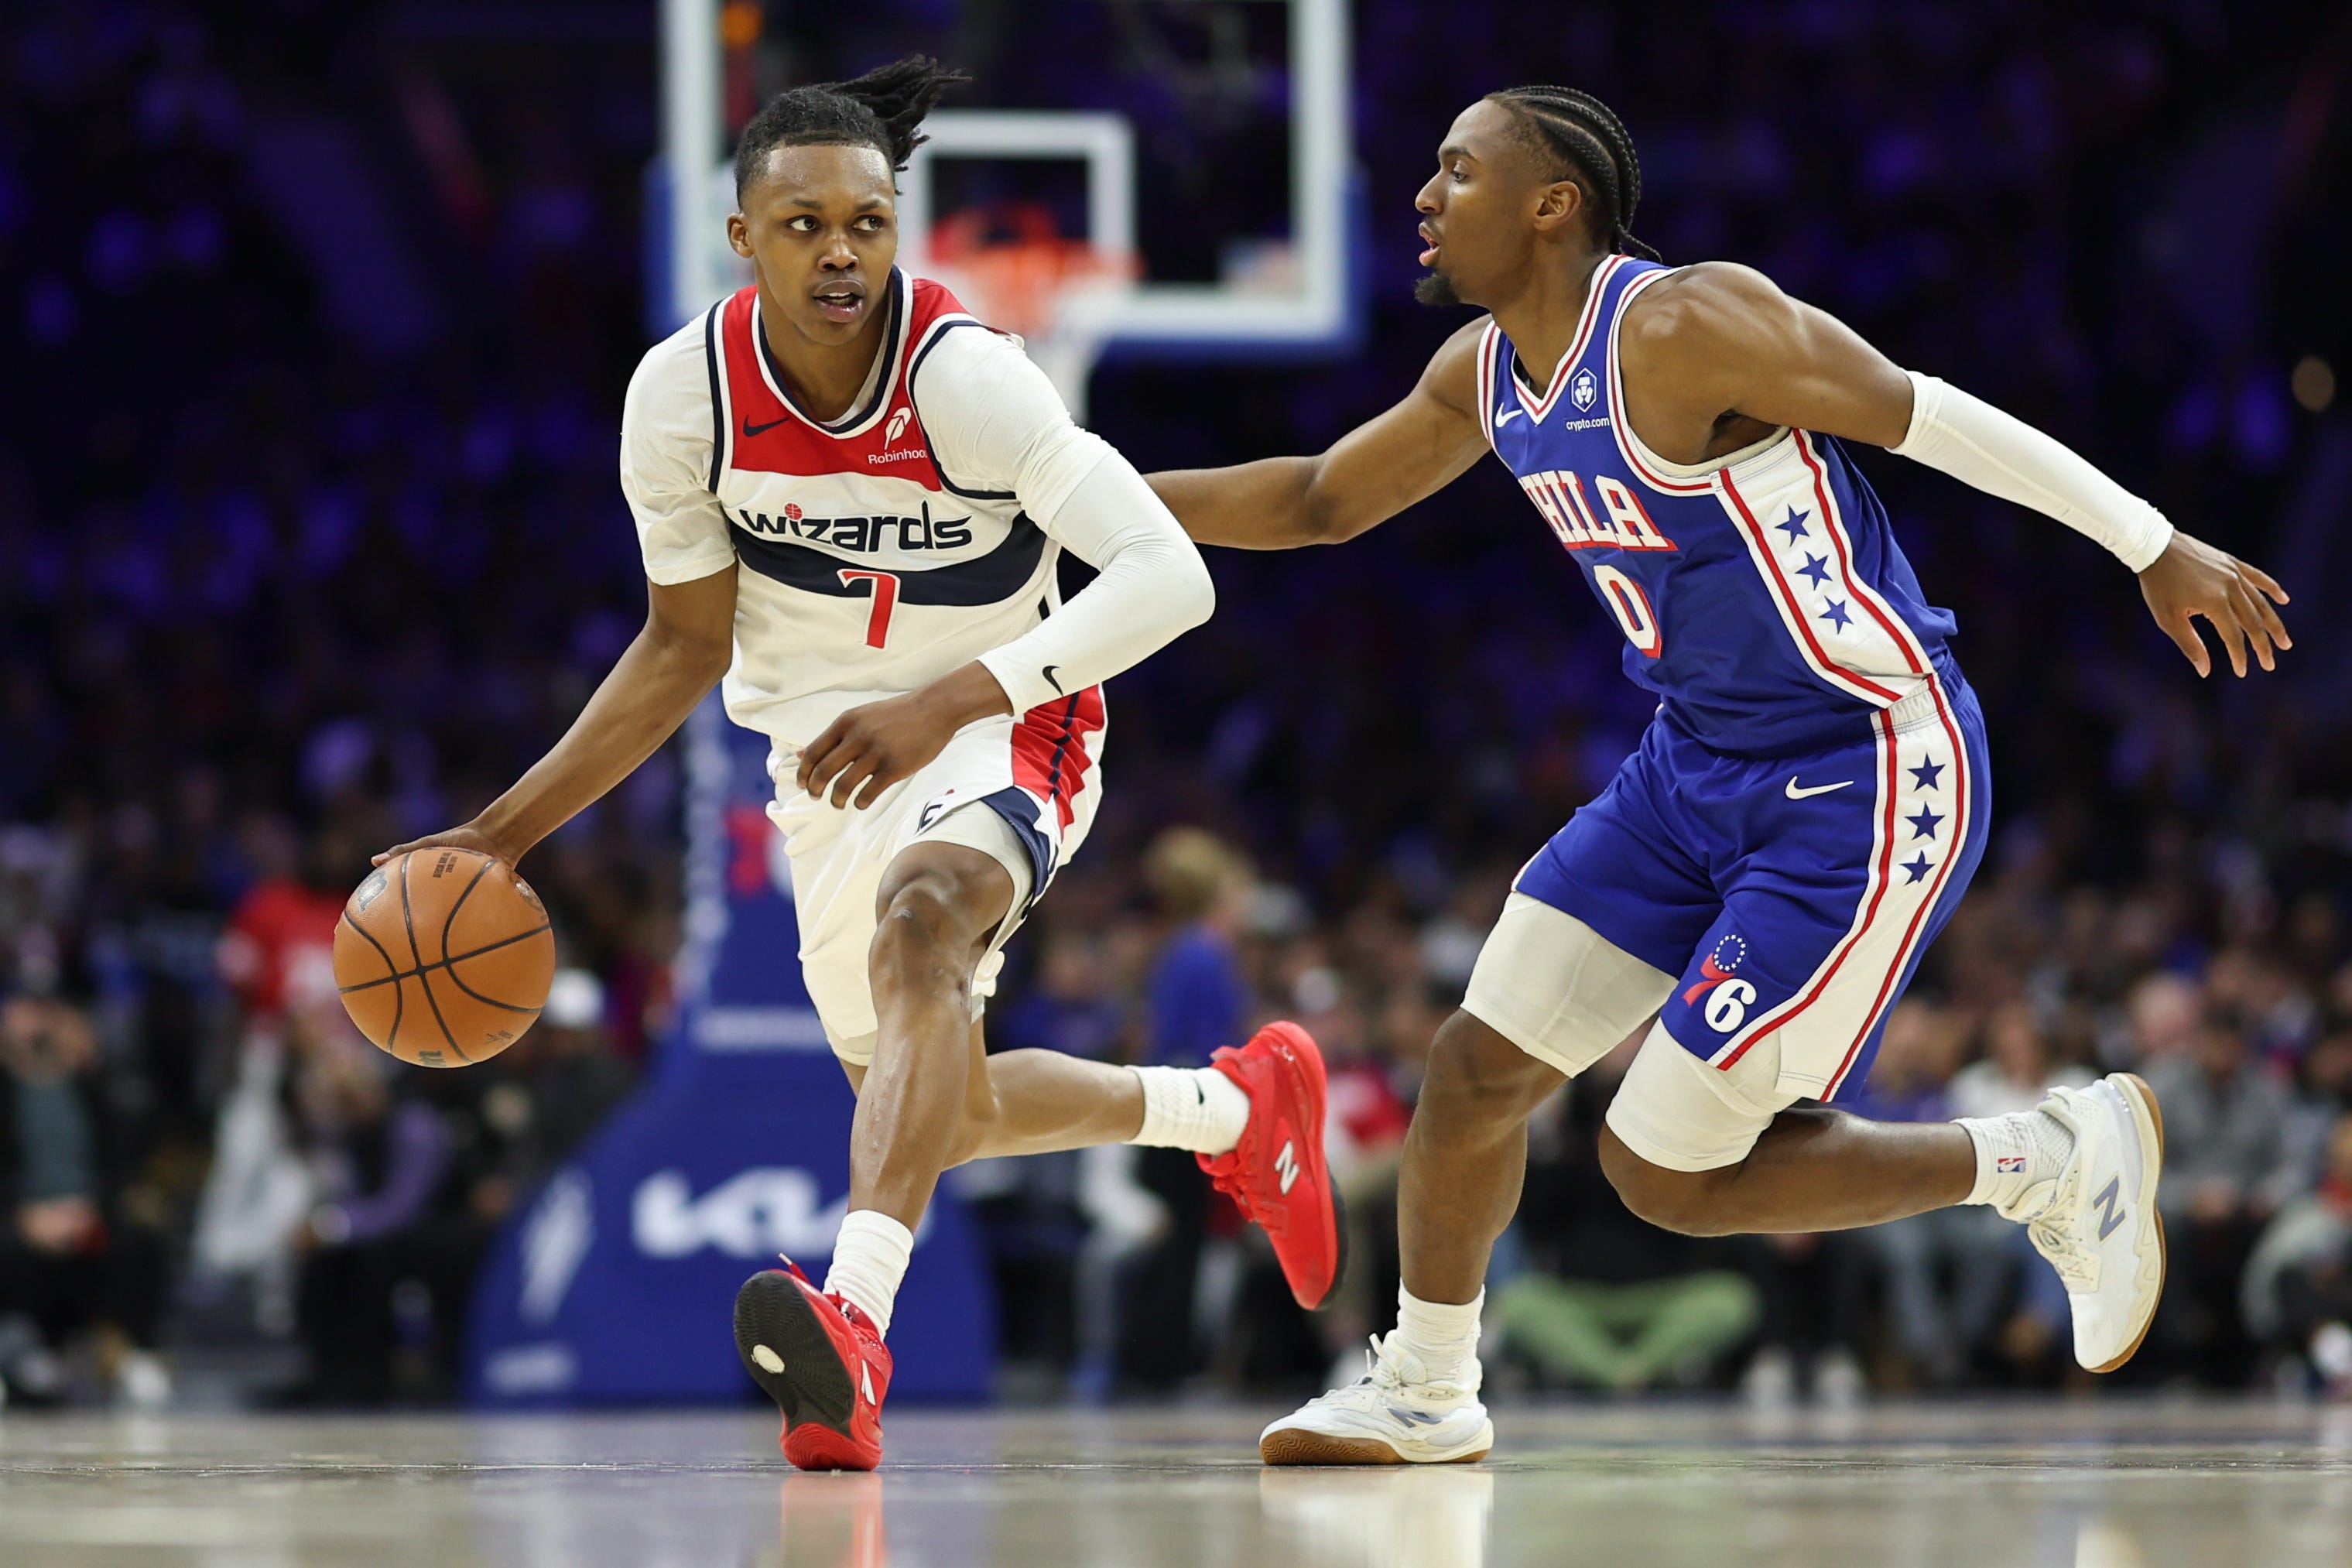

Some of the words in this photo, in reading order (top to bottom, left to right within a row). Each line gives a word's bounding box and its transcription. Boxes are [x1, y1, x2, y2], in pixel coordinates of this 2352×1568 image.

[867, 447, 928, 465] Robinhoo
[1566, 417, 1610, 432] crypto.com
[738, 499, 973, 553] wizards
[1518, 470, 1679, 551] HILA
[837, 568, 901, 650] 7
[1593, 563, 1662, 659] 0
